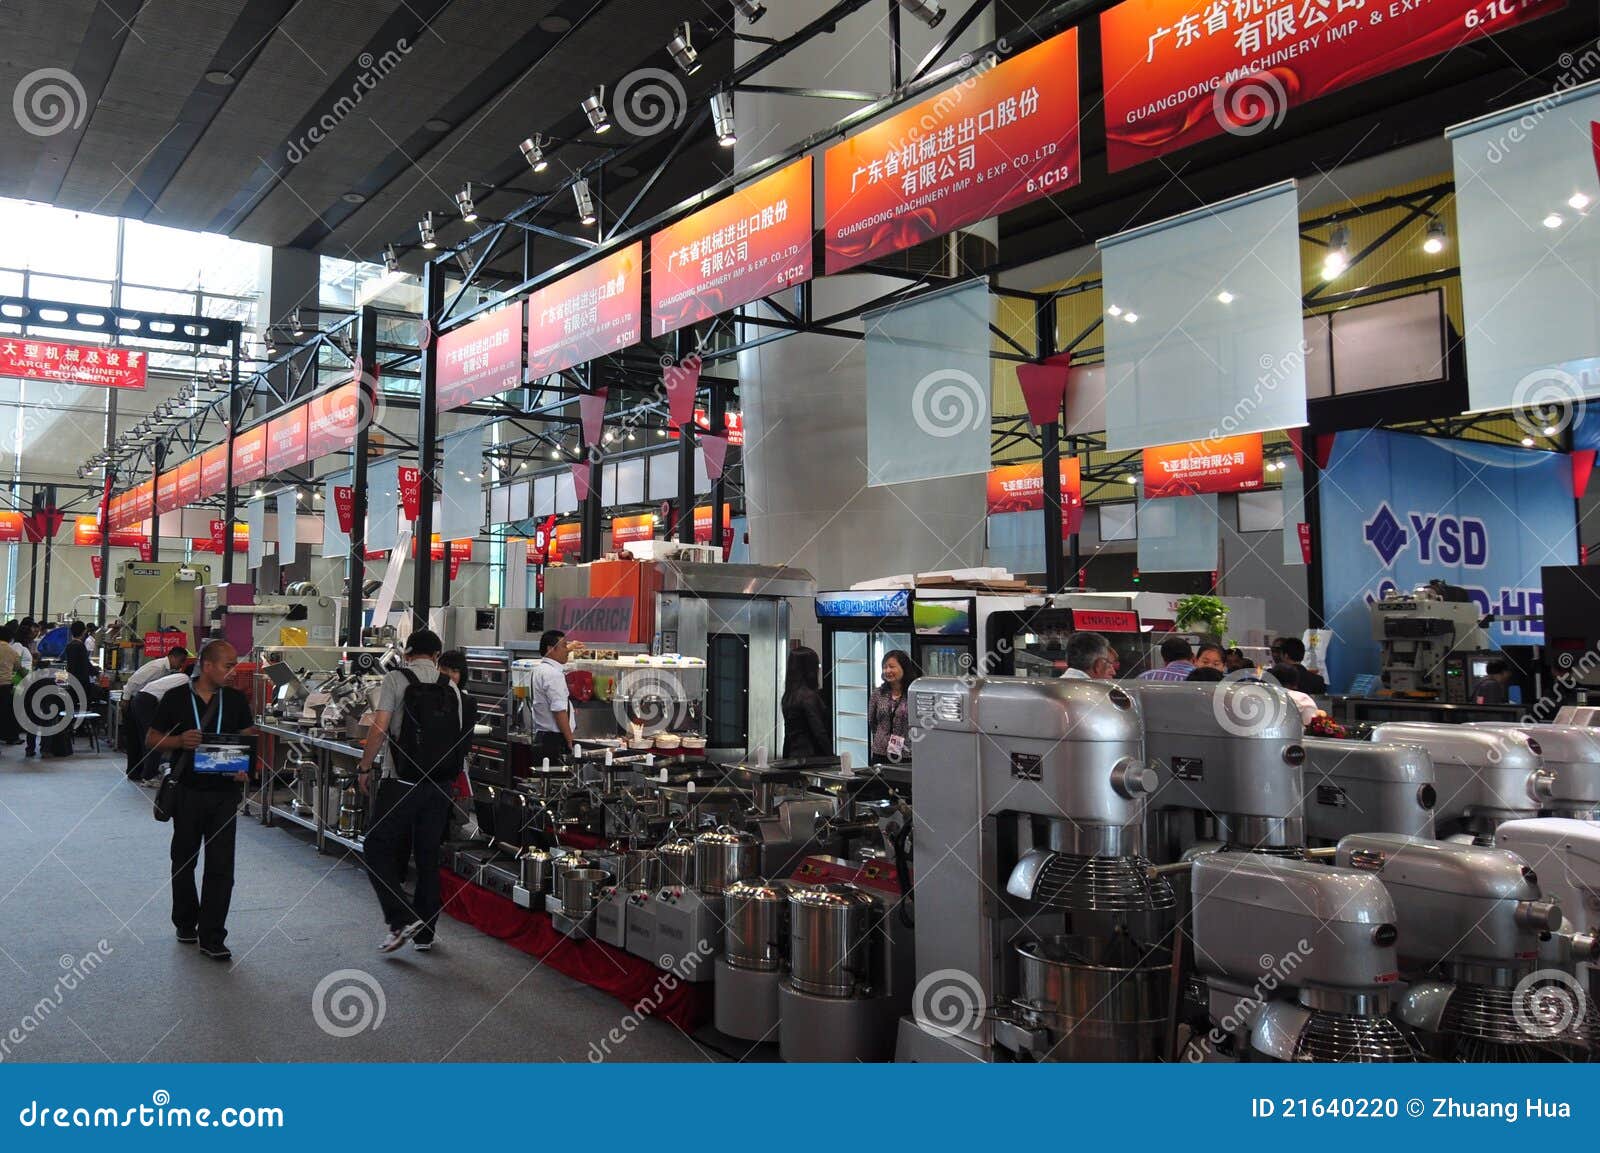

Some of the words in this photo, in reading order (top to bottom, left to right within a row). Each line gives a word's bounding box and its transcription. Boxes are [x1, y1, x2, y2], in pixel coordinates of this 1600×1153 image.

[1126, 75, 1221, 125] GUANGDONG
[1224, 35, 1320, 85] MACHINERY
[1326, 19, 1364, 43] IMP.
[1369, 10, 1383, 26] &
[850, 86, 1040, 193] 广东省机械进出口股份
[900, 144, 976, 197] 有限公司
[1026, 166, 1069, 194] 6.1C13
[837, 208, 894, 239] GUANGDONG
[895, 186, 950, 216] MACHINERY
[976, 171, 984, 184] &
[987, 161, 1010, 181] EXP.
[667, 199, 789, 273] 广东省机械进出口股份
[700, 241, 749, 279] 有限公司
[777, 264, 805, 284] 6.1C12
[658, 286, 696, 309] GUANGDONG
[696, 273, 732, 295] MACHINERY
[10, 358, 51, 370] LARGE
[59, 363, 131, 378] MACHINERY
[404, 470, 418, 482] 6.1
[1158, 451, 1245, 473] 飞亚集团有限公司
[340, 488, 351, 499] 6.1
[1409, 513, 1488, 567] YSD
[561, 604, 633, 633] LINKRICH
[823, 600, 837, 612] ICE
[839, 599, 863, 613] COLD
[864, 599, 899, 612] DRINKS
[1081, 614, 1129, 627] LINKRICH
